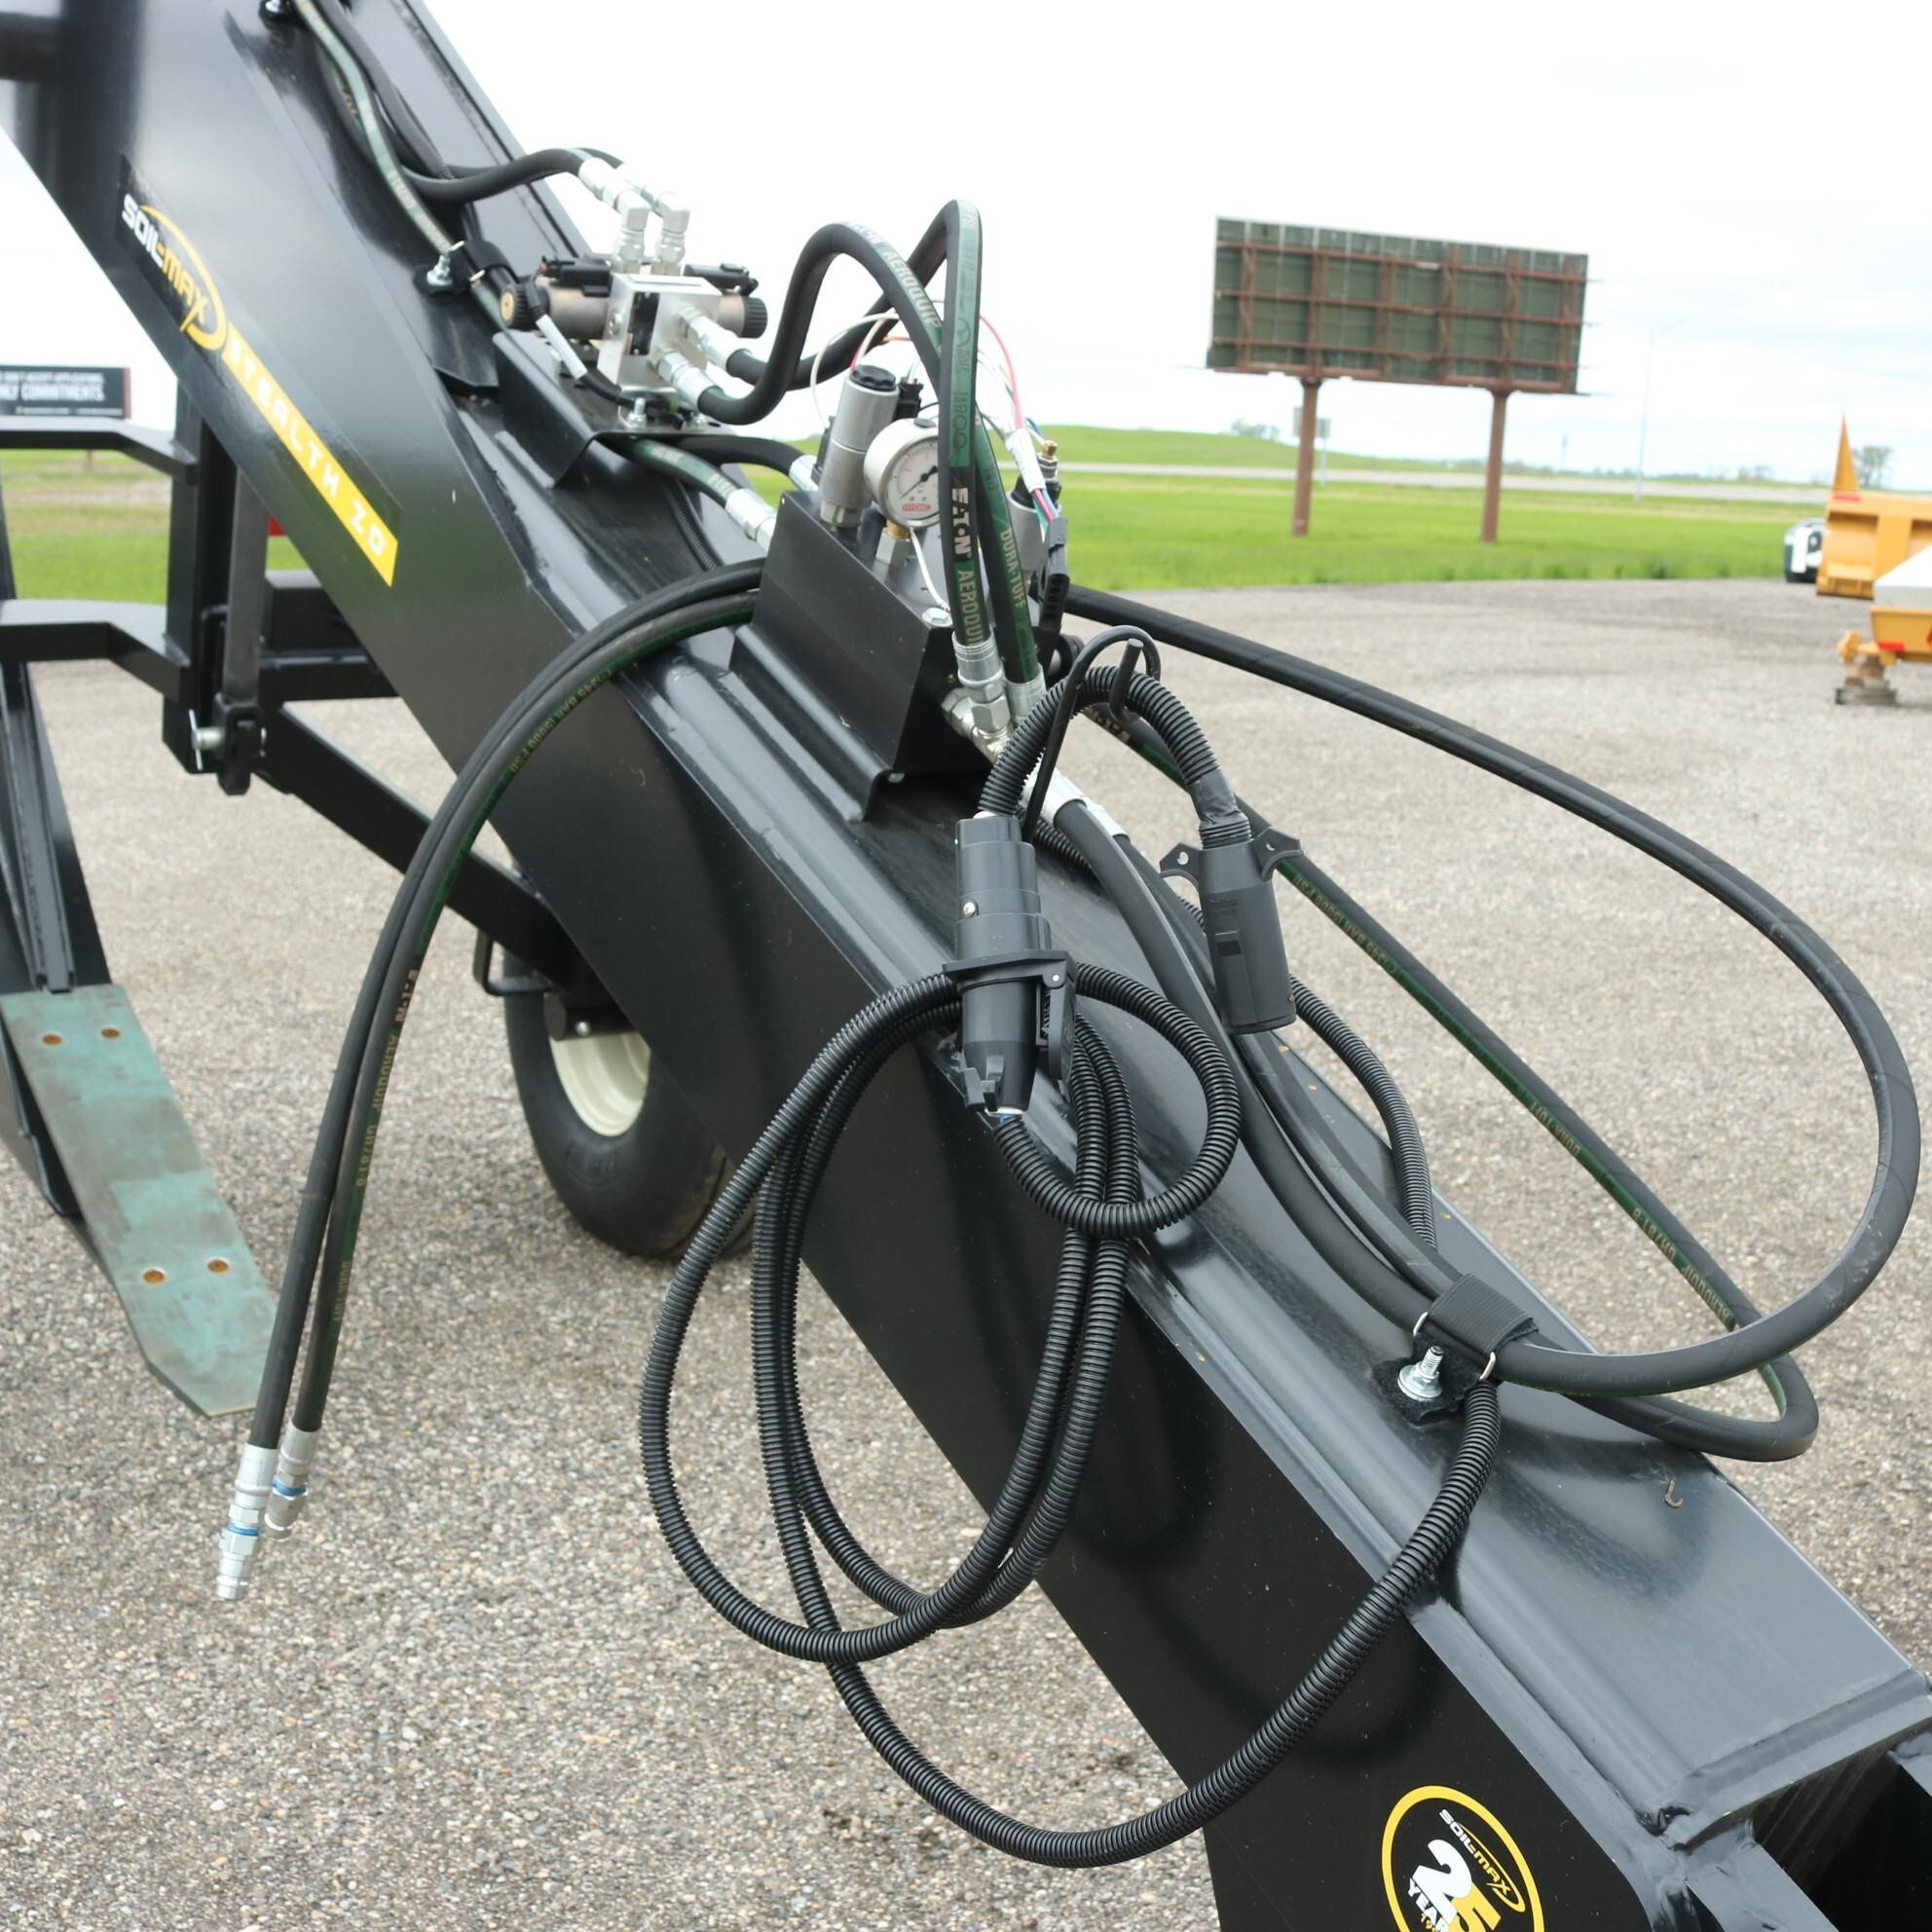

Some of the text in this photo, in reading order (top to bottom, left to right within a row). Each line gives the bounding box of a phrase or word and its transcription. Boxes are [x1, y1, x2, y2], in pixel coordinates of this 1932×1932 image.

[122, 194, 209, 331] SOIL-MAX
[880, 250, 944, 328] AEROQUIP
[230, 340, 340, 498] STEALTH
[957, 570, 989, 648] AEROQUI
[999, 529, 1027, 610] DURA-TUFF
[1439, 1808, 1513, 1898] SOIL-MAX
